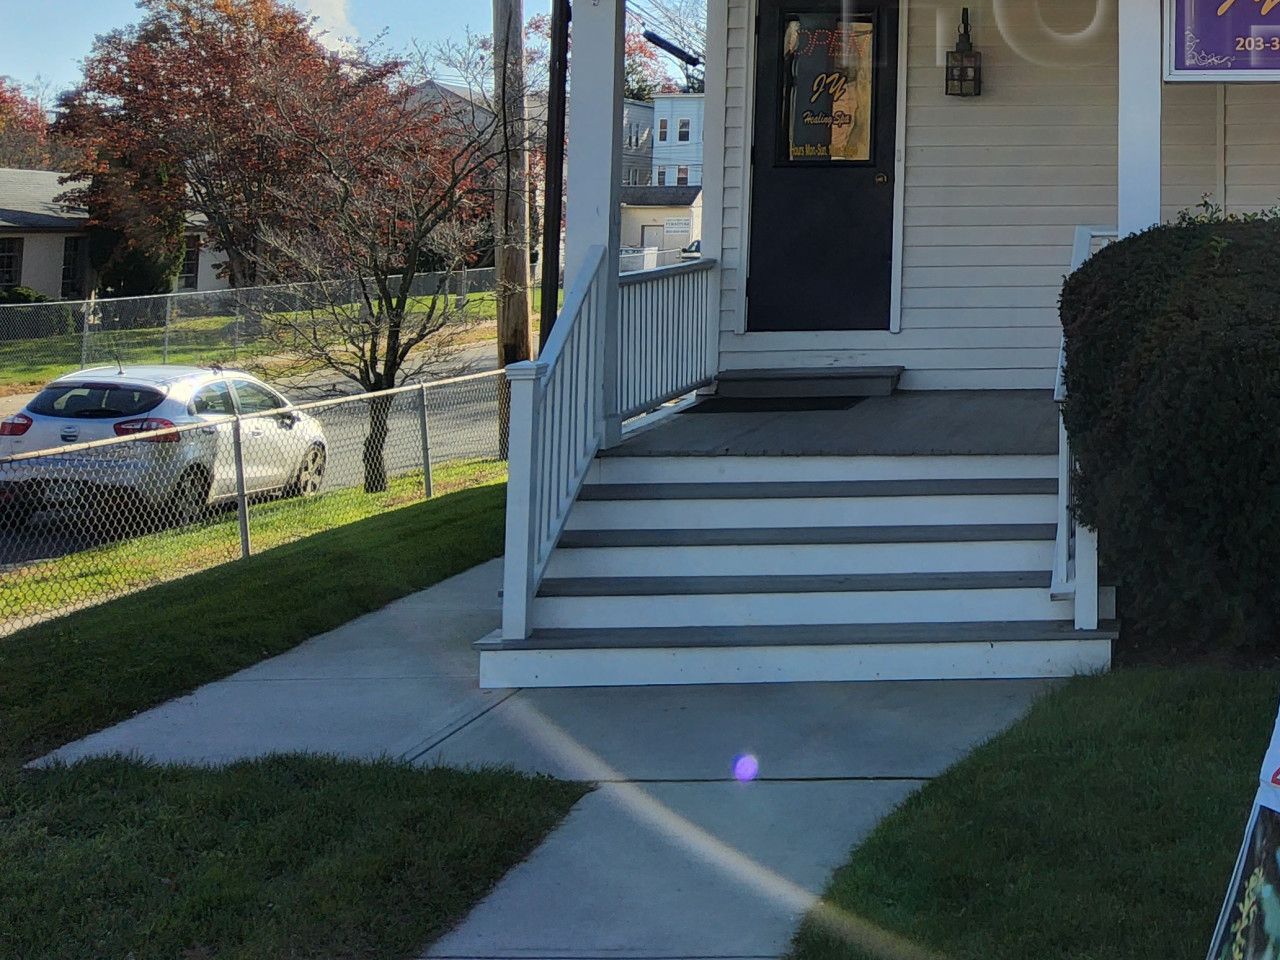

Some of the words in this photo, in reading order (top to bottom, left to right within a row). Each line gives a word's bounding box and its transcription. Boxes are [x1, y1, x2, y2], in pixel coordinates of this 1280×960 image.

[810, 72, 846, 103] JY
[803, 111, 833, 128] Healing
[833, 110, 851, 128] Spa
